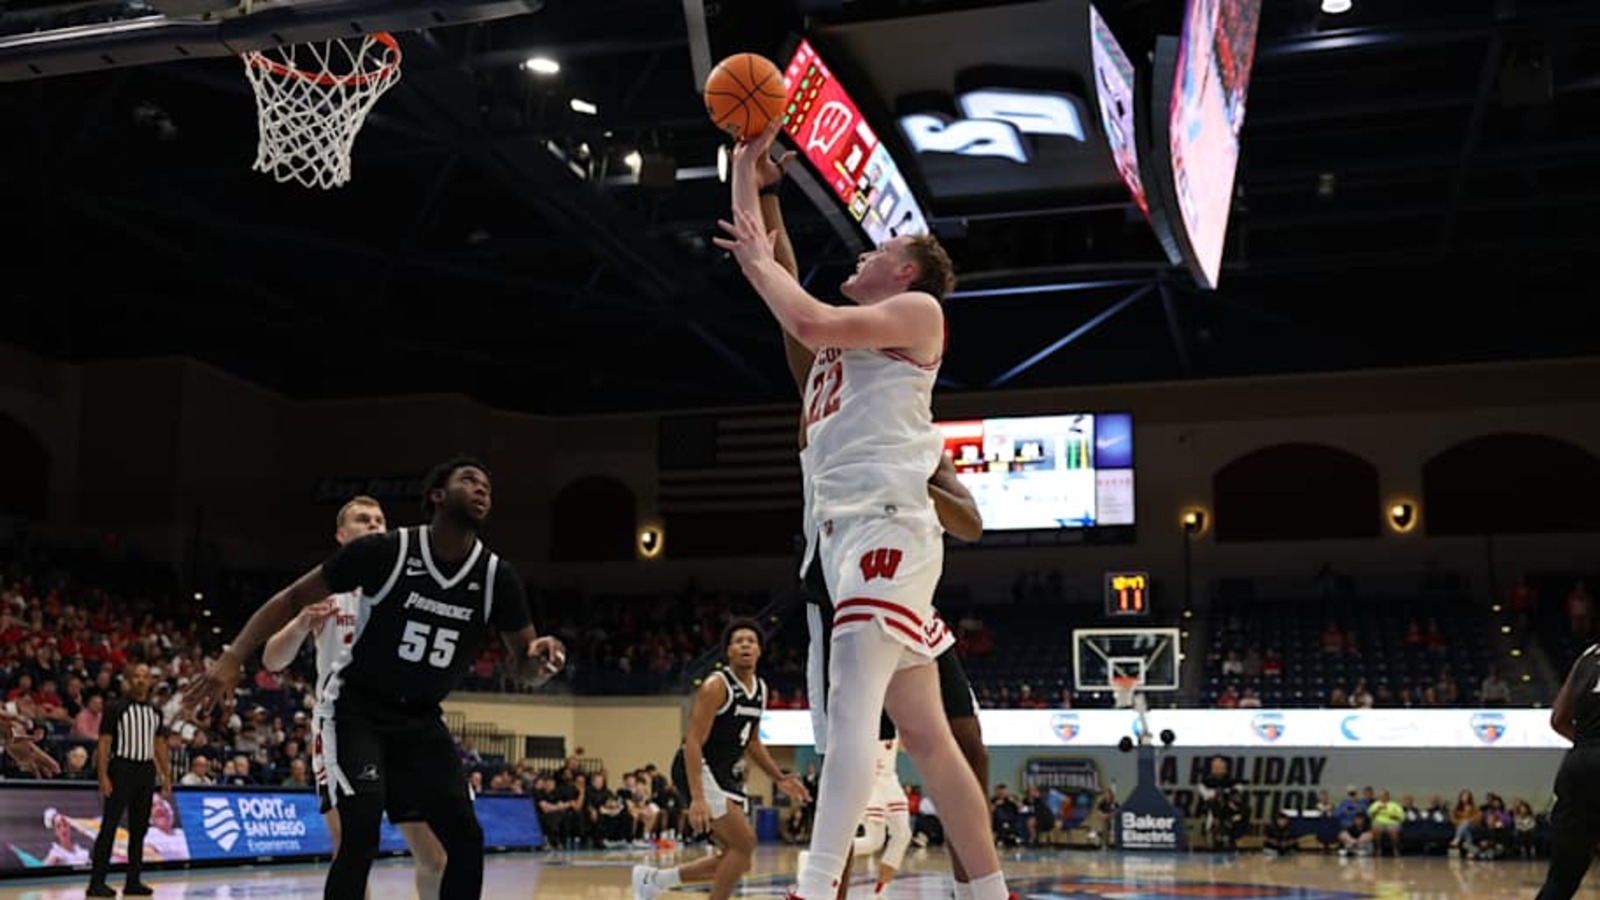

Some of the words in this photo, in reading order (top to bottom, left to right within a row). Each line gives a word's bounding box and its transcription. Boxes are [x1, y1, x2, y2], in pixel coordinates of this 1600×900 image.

[805, 361, 842, 428] 22
[859, 548, 903, 582] W
[1120, 589, 1142, 610] 11
[398, 620, 460, 668] 55
[740, 721, 752, 746] 4
[1160, 756, 1177, 785] A
[238, 798, 283, 819] PORT
[284, 804, 296, 819] of
[243, 821, 269, 837] SAN
[270, 820, 306, 836] DIEGO
[1122, 812, 1174, 829] Baker
[1122, 830, 1175, 843] Electric
